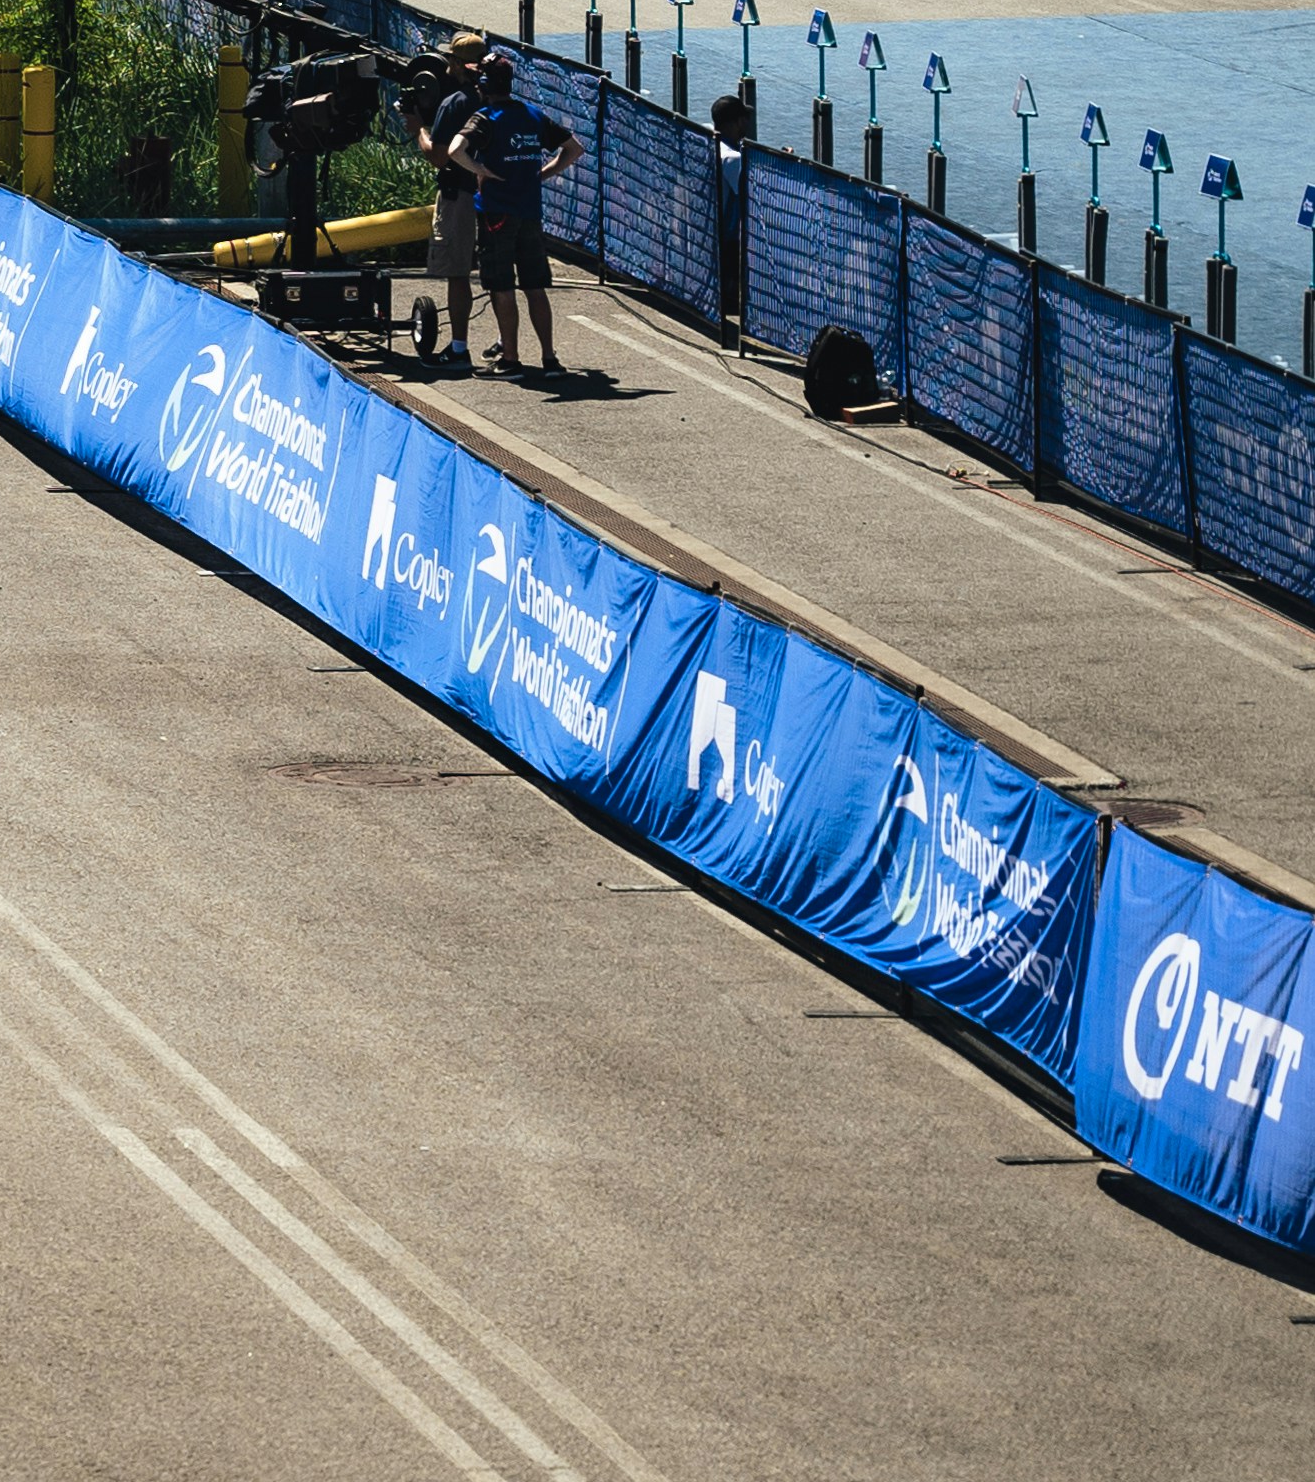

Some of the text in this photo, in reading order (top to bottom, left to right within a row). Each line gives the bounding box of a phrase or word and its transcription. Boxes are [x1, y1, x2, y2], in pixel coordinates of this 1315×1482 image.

[82, 351, 138, 424] Copley
[205, 430, 274, 506] World
[263, 455, 321, 545] Triathlon
[393, 532, 454, 621] Copley
[516, 556, 617, 674] Championnats
[511, 626, 558, 709] World
[1184, 989, 1305, 1124] NTT
